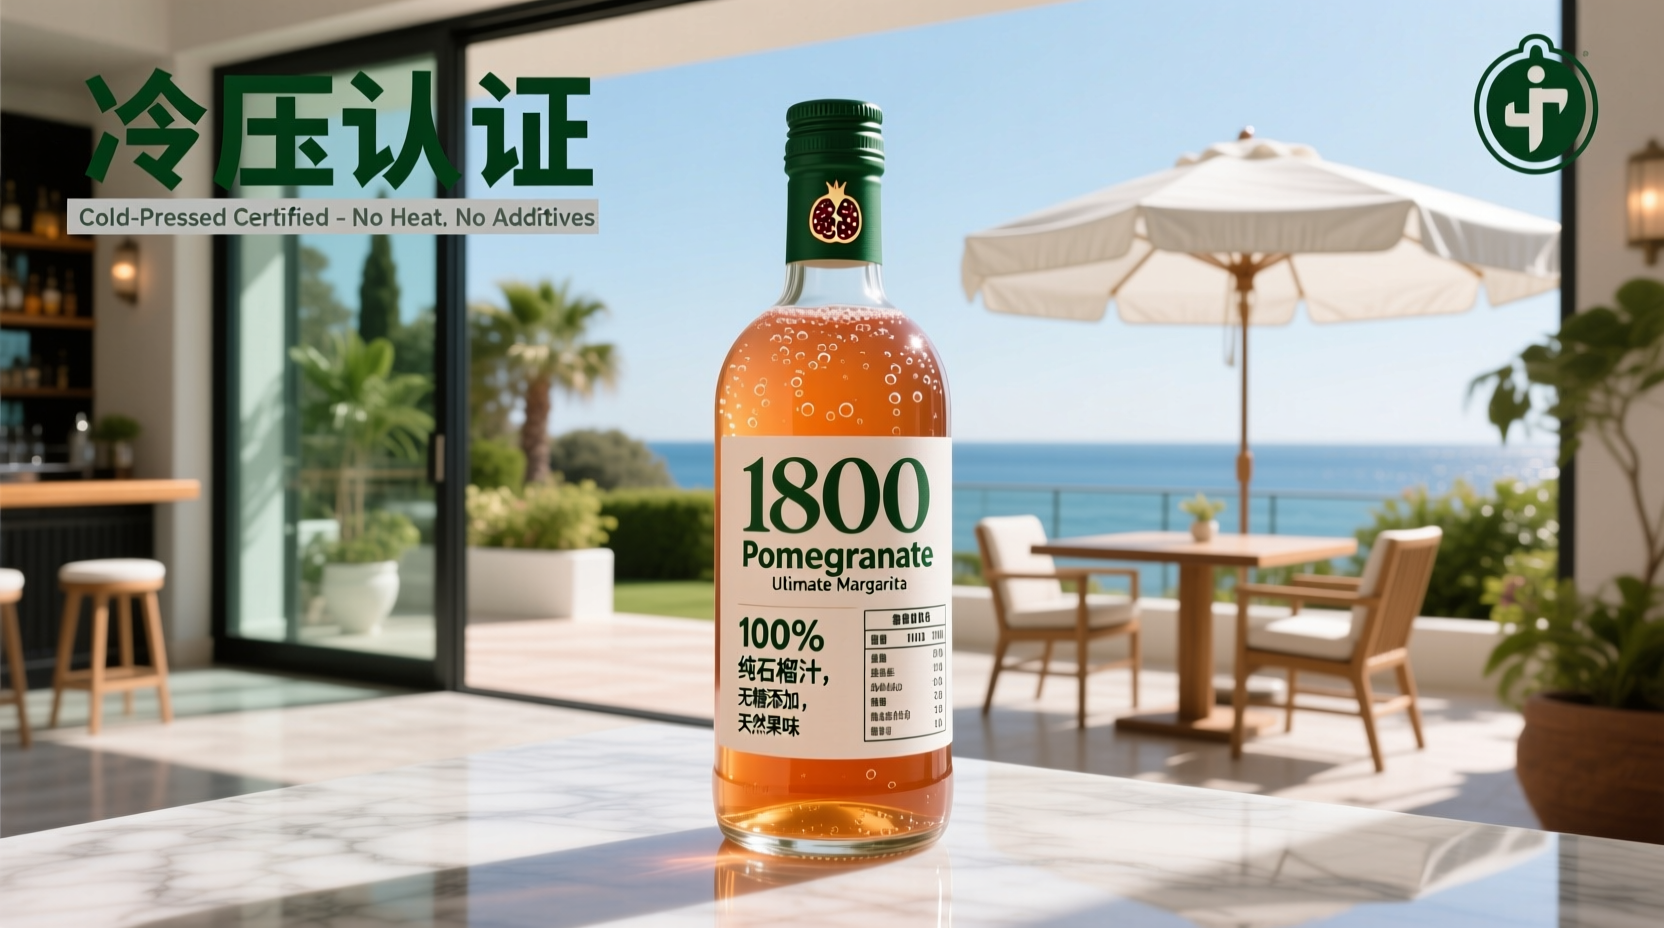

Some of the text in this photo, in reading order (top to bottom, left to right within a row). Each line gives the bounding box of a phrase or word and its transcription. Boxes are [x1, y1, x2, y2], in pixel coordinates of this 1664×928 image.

[743, 456, 930, 535] 1800
[742, 540, 934, 577] Pomegranate
[837, 576, 907, 595] Margarita
[739, 616, 825, 652] 100%
[738, 712, 800, 737] 天然果味
